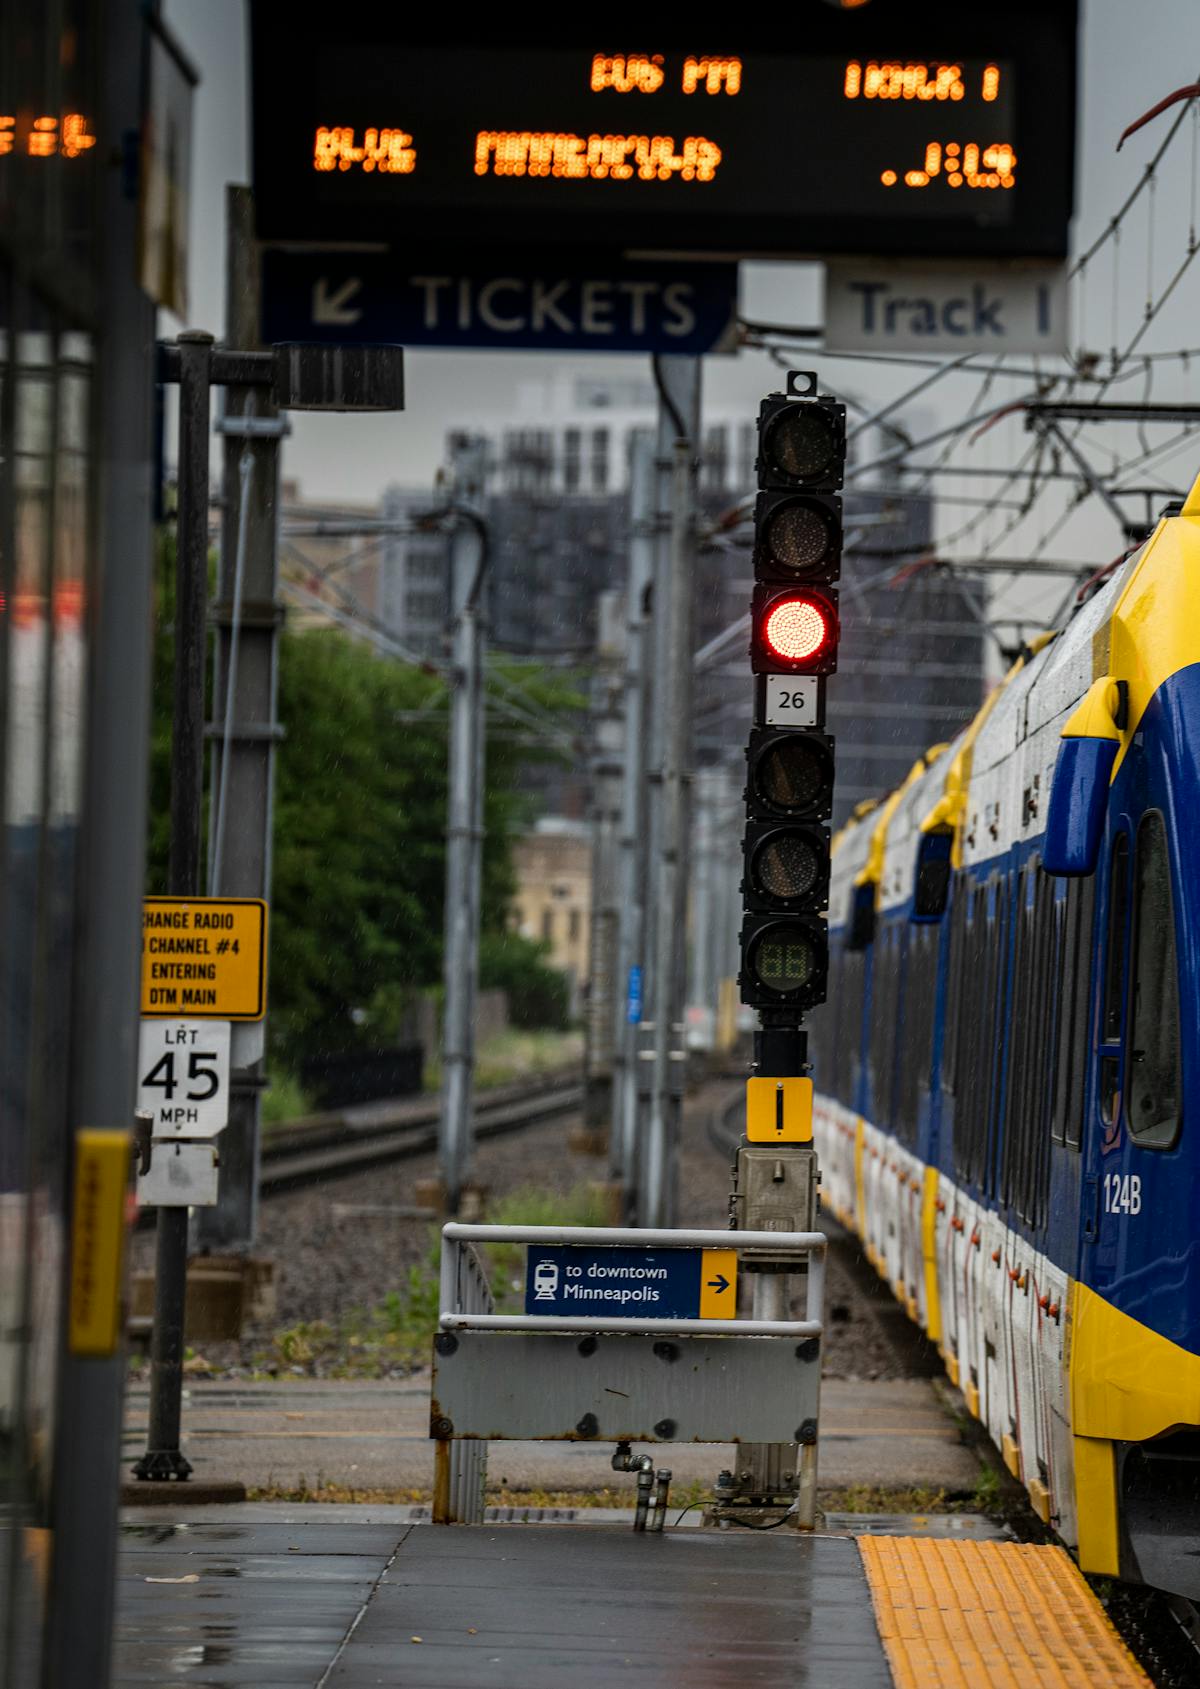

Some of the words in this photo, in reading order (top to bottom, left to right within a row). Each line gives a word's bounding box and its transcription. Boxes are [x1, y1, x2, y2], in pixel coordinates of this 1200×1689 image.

[410, 277, 696, 336] TICKETS
[847, 281, 1005, 337] Track
[778, 691, 805, 709] 26
[142, 912, 190, 929] HANGE
[194, 913, 234, 930] RADIO
[149, 937, 211, 954] CHANNEL
[151, 962, 216, 980] ENTERING
[182, 988, 216, 1005] MAIN
[165, 1029, 199, 1045] LRT
[142, 1051, 219, 1101] 45
[160, 1108, 198, 1123] MPH
[1104, 1174, 1141, 1215] 124B
[566, 1265, 582, 1277] to
[587, 1263, 668, 1279] downtown
[564, 1284, 660, 1304] Minneapolis
